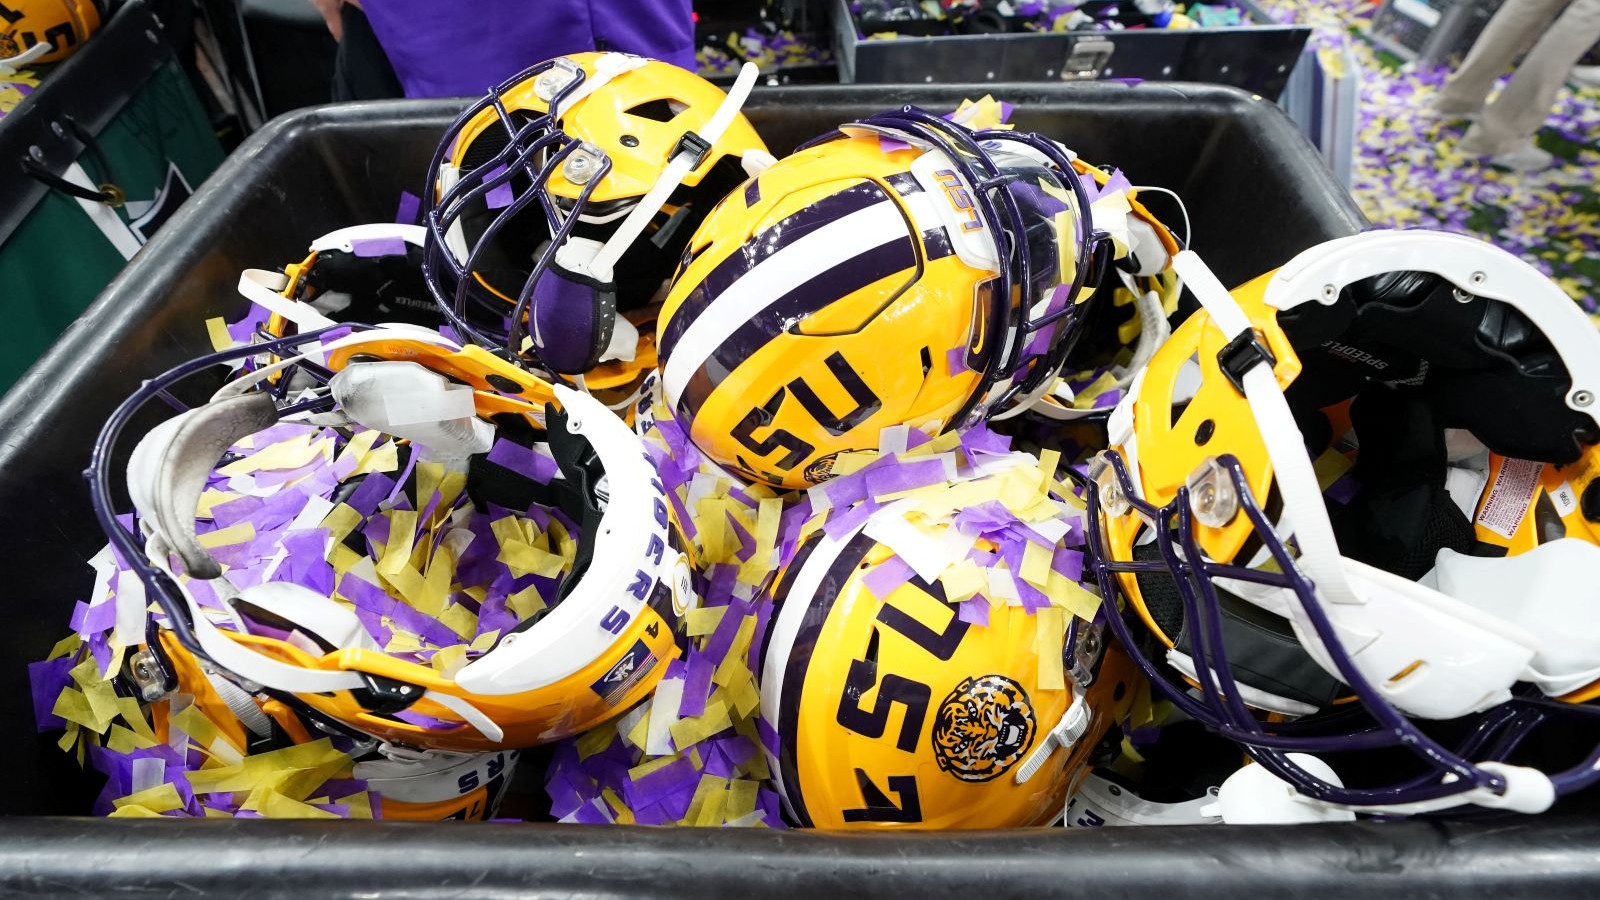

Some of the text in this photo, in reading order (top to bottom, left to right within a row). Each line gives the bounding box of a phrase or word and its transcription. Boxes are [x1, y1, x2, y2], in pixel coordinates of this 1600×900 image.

[935, 168, 983, 234] LSU
[1478, 457, 1511, 522] WARNING WARNIN
[1507, 502, 1528, 537] WARNING
[1525, 464, 1543, 500] WARNING
[644, 620, 659, 640] 4
[836, 573, 973, 823] LSU
